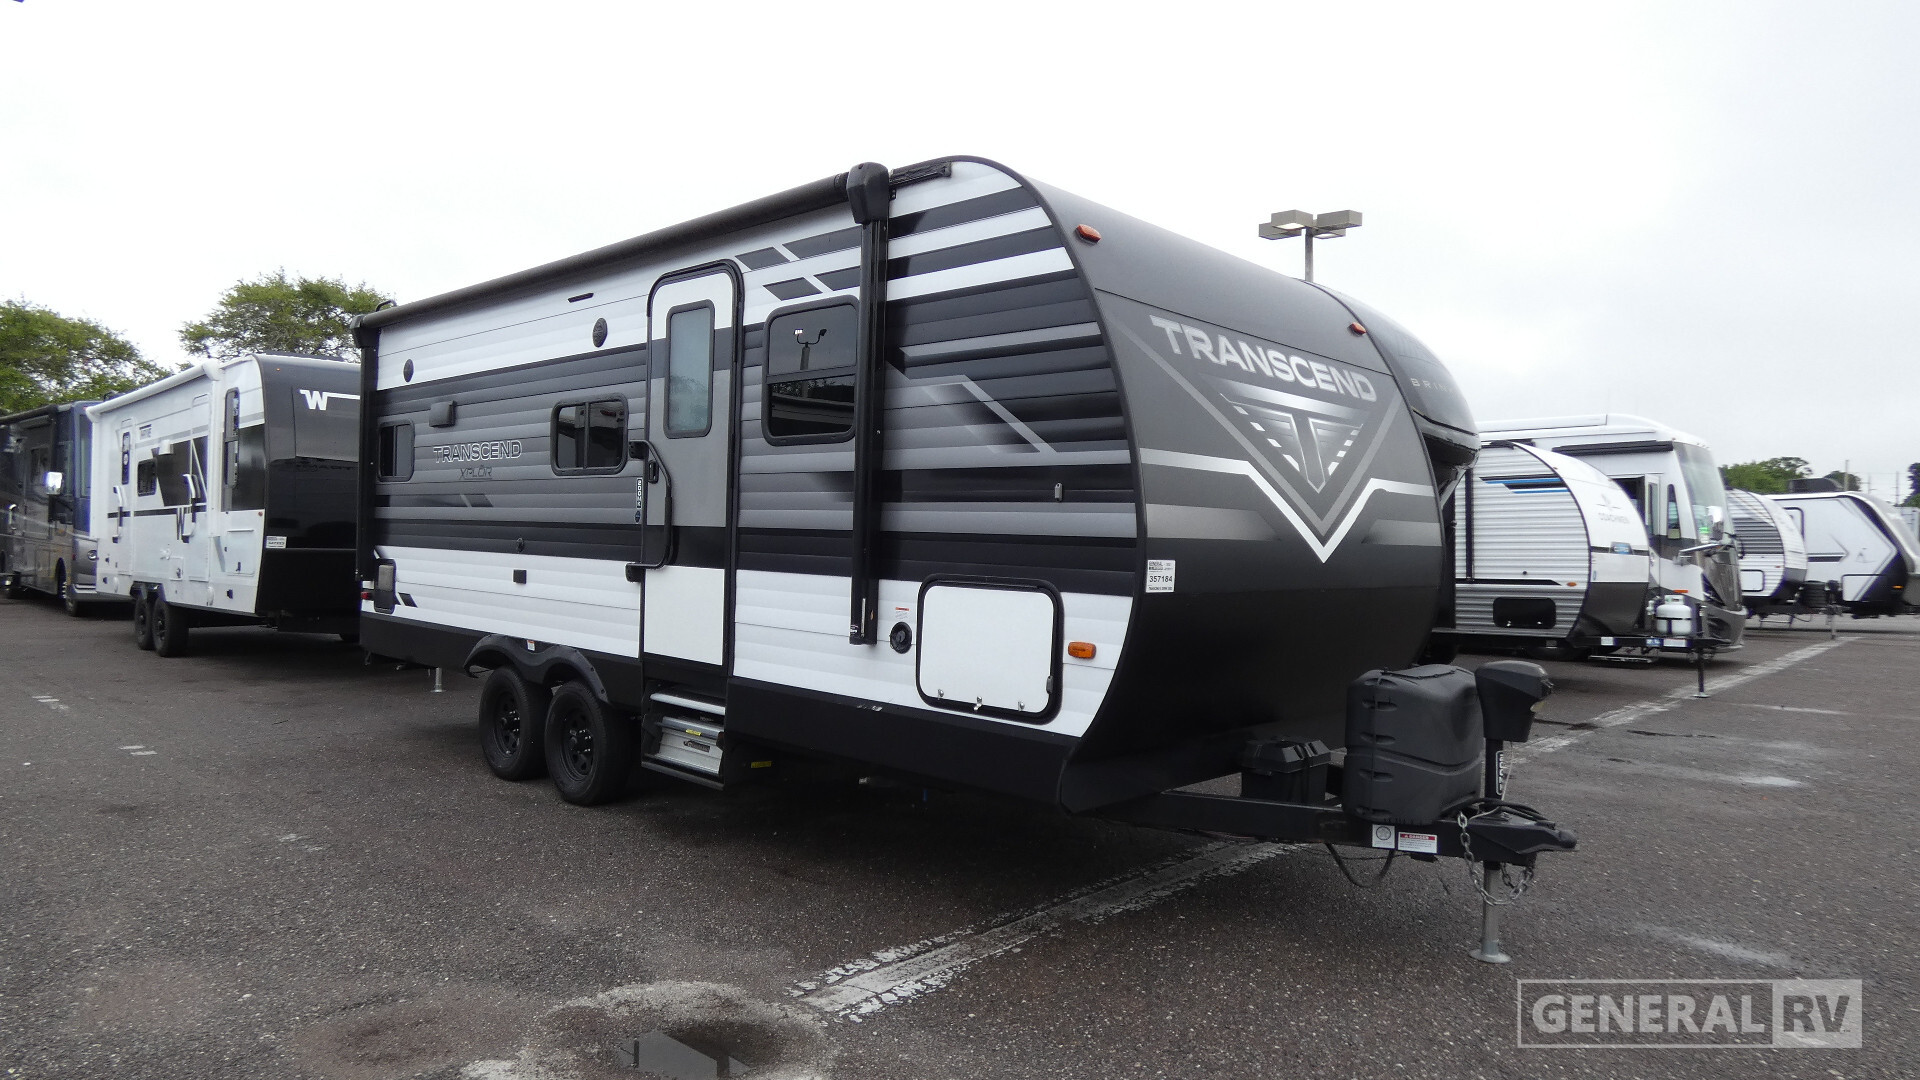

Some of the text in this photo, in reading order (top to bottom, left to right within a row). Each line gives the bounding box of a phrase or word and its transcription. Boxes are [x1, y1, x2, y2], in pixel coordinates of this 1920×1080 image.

[1150, 315, 1377, 402] TRANSCEND
[433, 440, 522, 463] TRANSCEND
[1150, 575, 1173, 583] 357184
